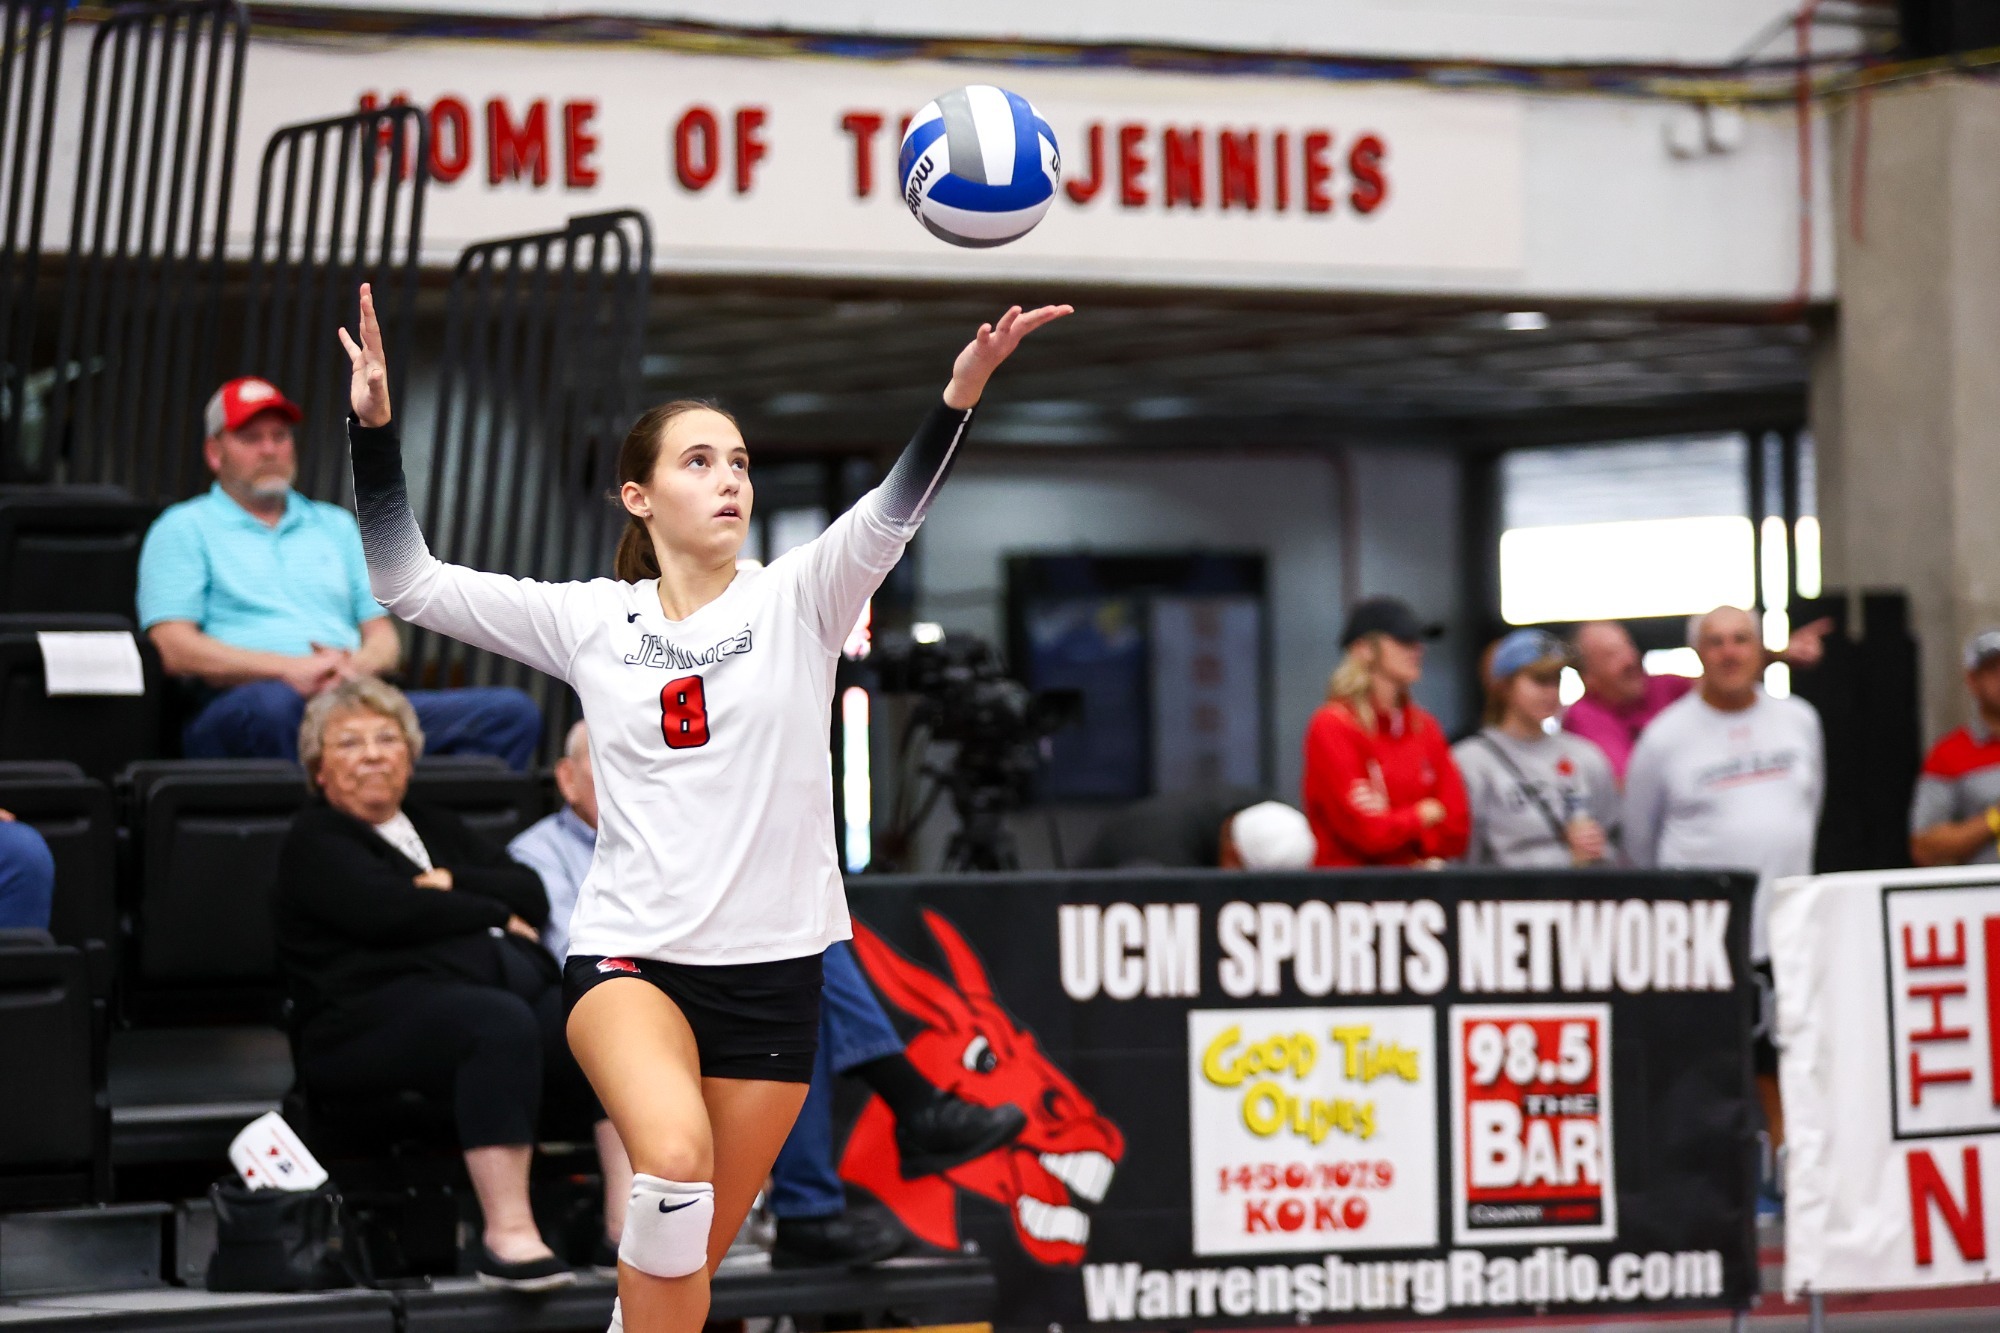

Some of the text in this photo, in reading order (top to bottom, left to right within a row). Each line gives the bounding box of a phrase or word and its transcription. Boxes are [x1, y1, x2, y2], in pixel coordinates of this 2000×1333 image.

[673, 104, 770, 194] OF
[1065, 120, 1390, 214] JENNIES
[907, 155, 934, 216] molte
[660, 674, 710, 749] 8
[1058, 899, 1734, 1000] UCM SPORTS NETWORK
[1903, 918, 1972, 1107] THE
[1468, 1022, 1594, 1085] 98.5
[1524, 1094, 1599, 1115] THE
[1244, 1197, 1370, 1234] KOKO
[1083, 1250, 1724, 1321] WarrensburgRadio.com
